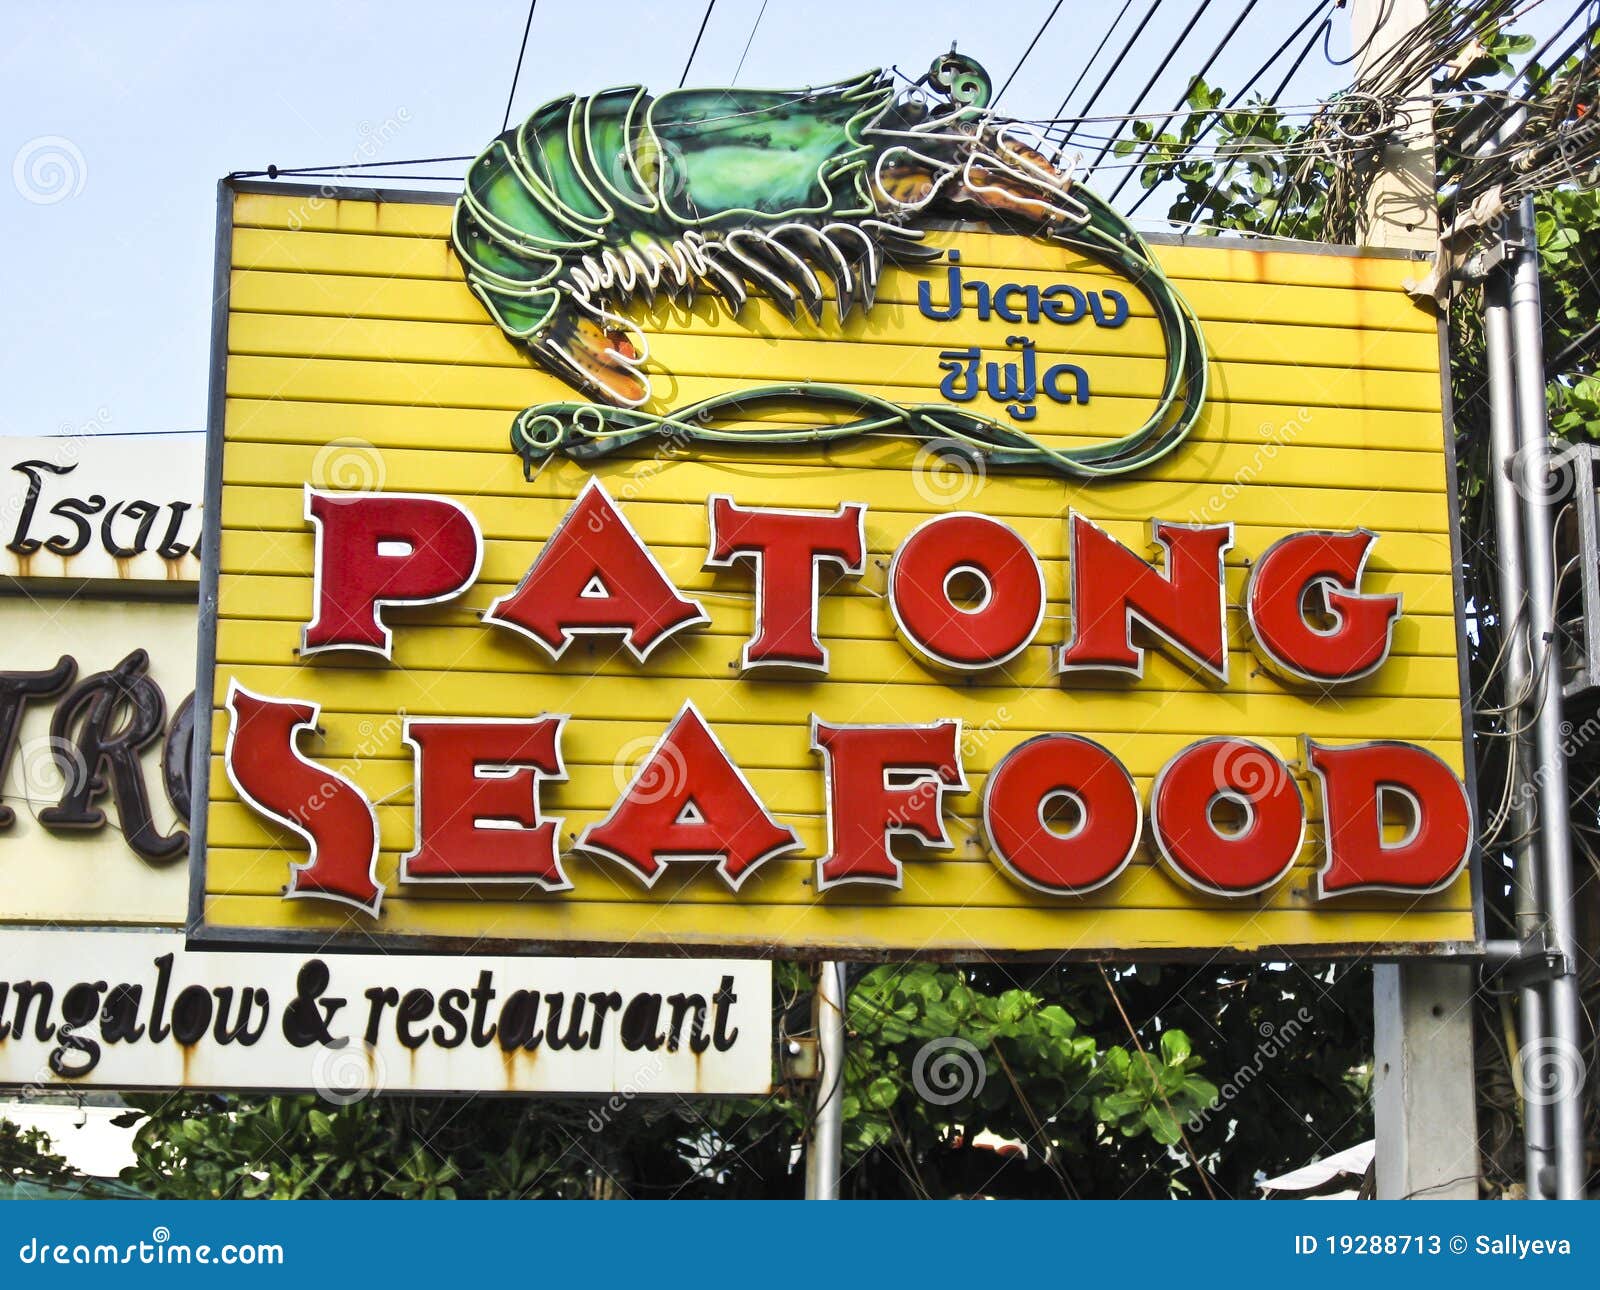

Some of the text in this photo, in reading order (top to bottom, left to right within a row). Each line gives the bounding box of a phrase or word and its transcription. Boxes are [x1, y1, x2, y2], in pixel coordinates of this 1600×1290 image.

[917, 249, 1129, 327] ป่าตอง
[299, 475, 1402, 686] PATONG
[225, 676, 1474, 920] SEAFOOD
[282, 959, 348, 1050] &
[364, 970, 739, 1053] restaurant
